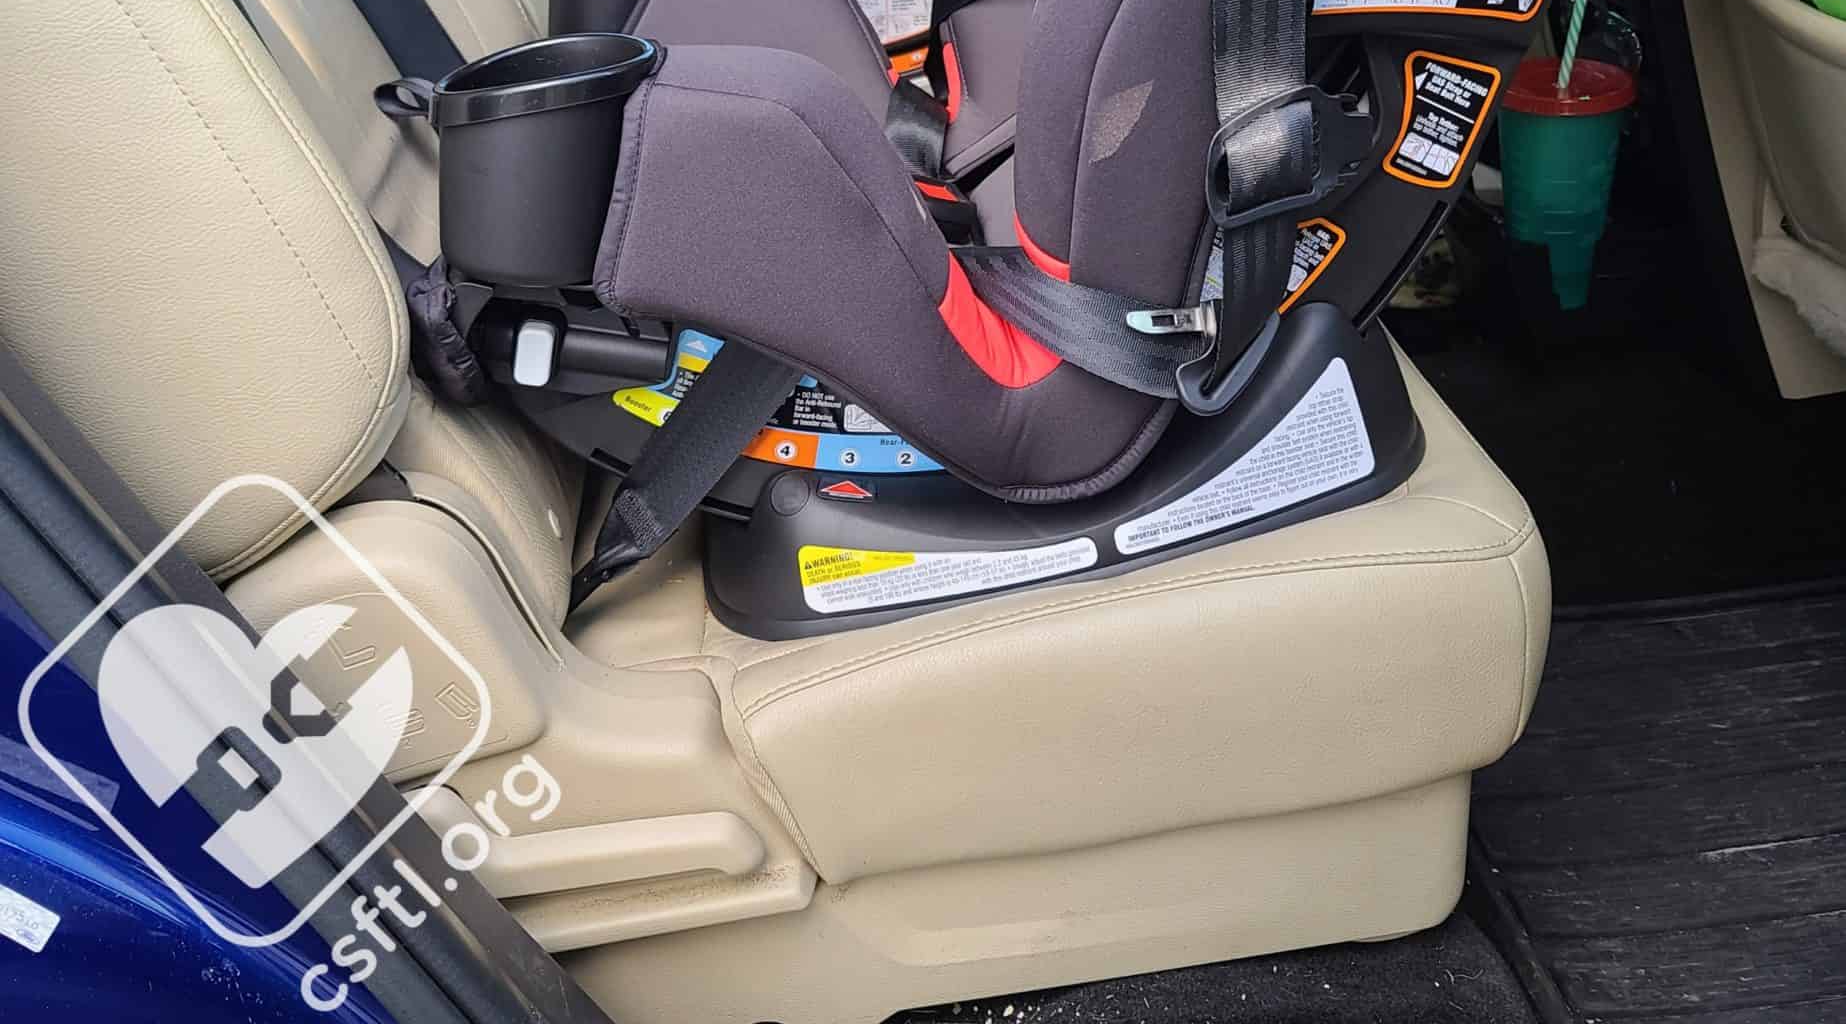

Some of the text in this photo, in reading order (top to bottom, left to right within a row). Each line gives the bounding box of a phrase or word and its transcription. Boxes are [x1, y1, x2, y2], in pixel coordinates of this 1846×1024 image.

[1425, 62, 1488, 97] FORWARD-FACING
[780, 445, 790, 456] 4
[845, 451, 856, 464] 3
[900, 452, 912, 465] 2
[1170, 521, 1193, 533] FOLLOW
[1205, 510, 1231, 524] OWNER'S
[812, 551, 853, 568] WARNING!
